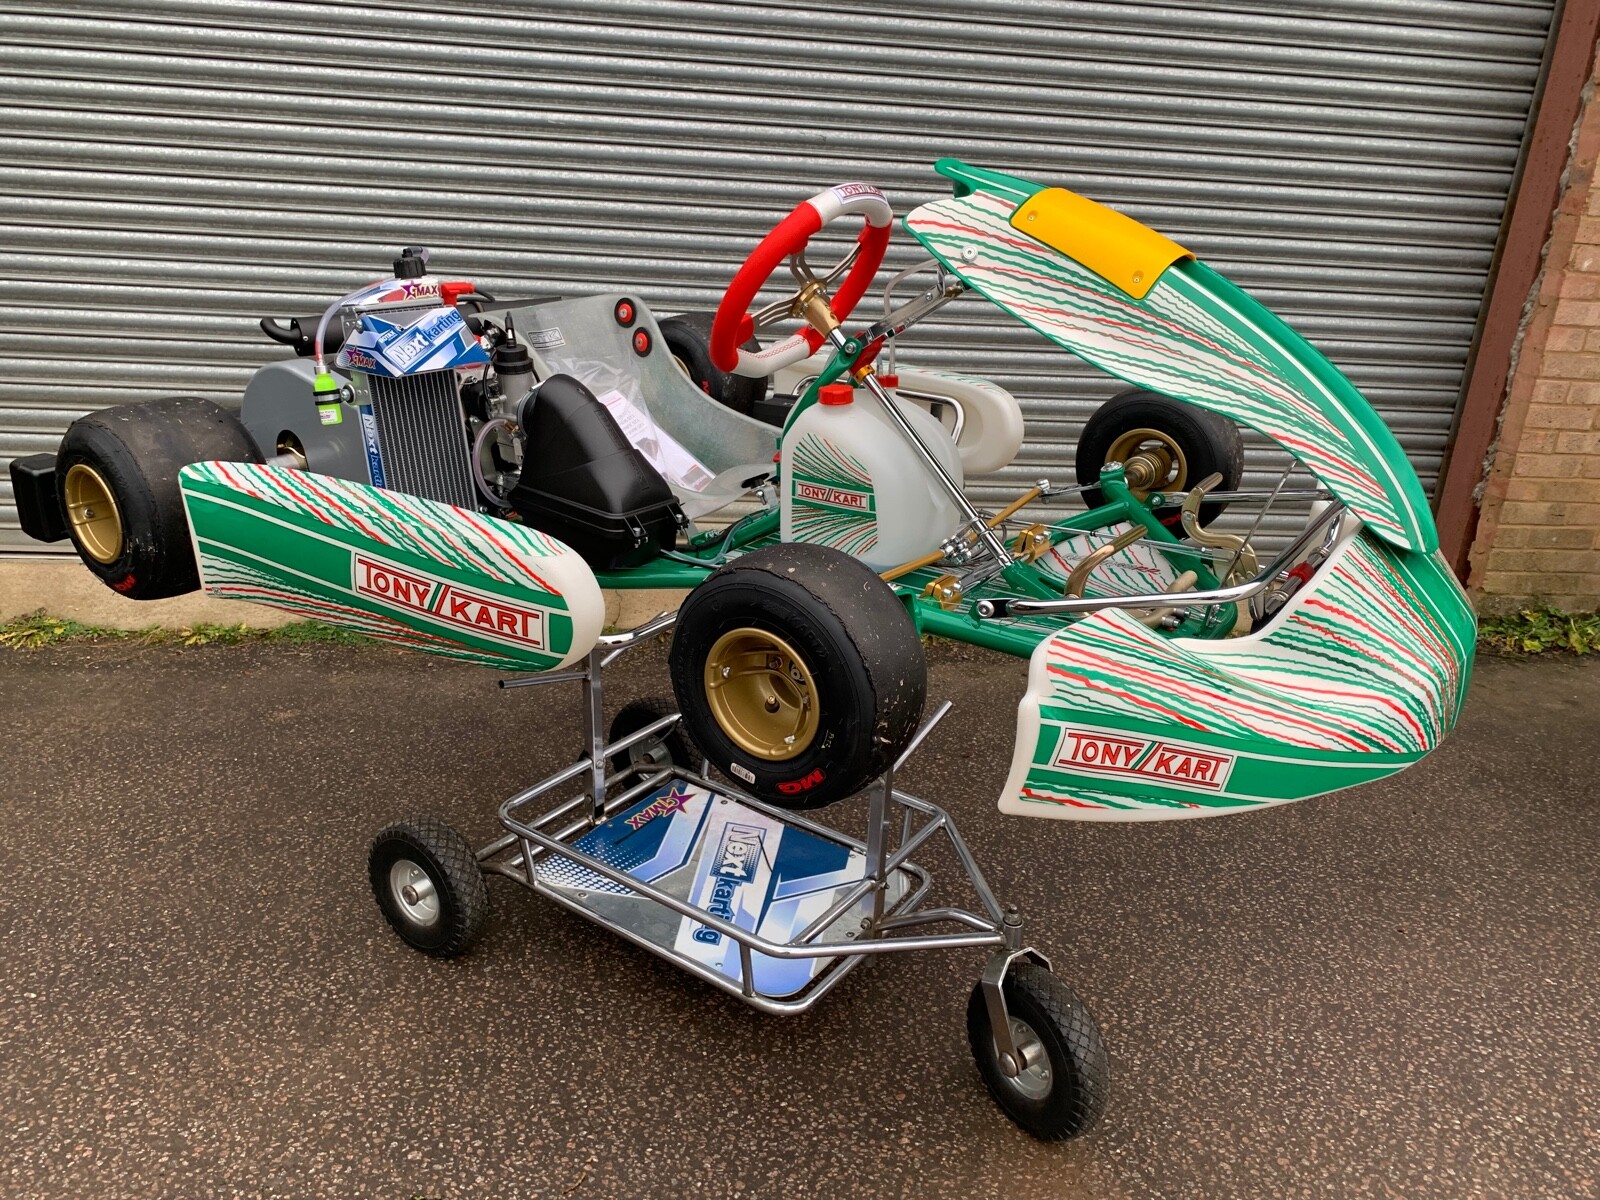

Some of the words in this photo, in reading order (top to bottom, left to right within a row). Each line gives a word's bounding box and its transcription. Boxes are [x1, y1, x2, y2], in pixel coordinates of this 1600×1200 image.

[391, 332, 429, 366] Next
[423, 310, 463, 341] karting
[358, 558, 431, 607] TONY
[450, 590, 540, 637] KART
[1067, 732, 1145, 767] TONY
[1153, 746, 1230, 782] KART
[720, 825, 761, 879] Next
[693, 877, 742, 946] kartig
